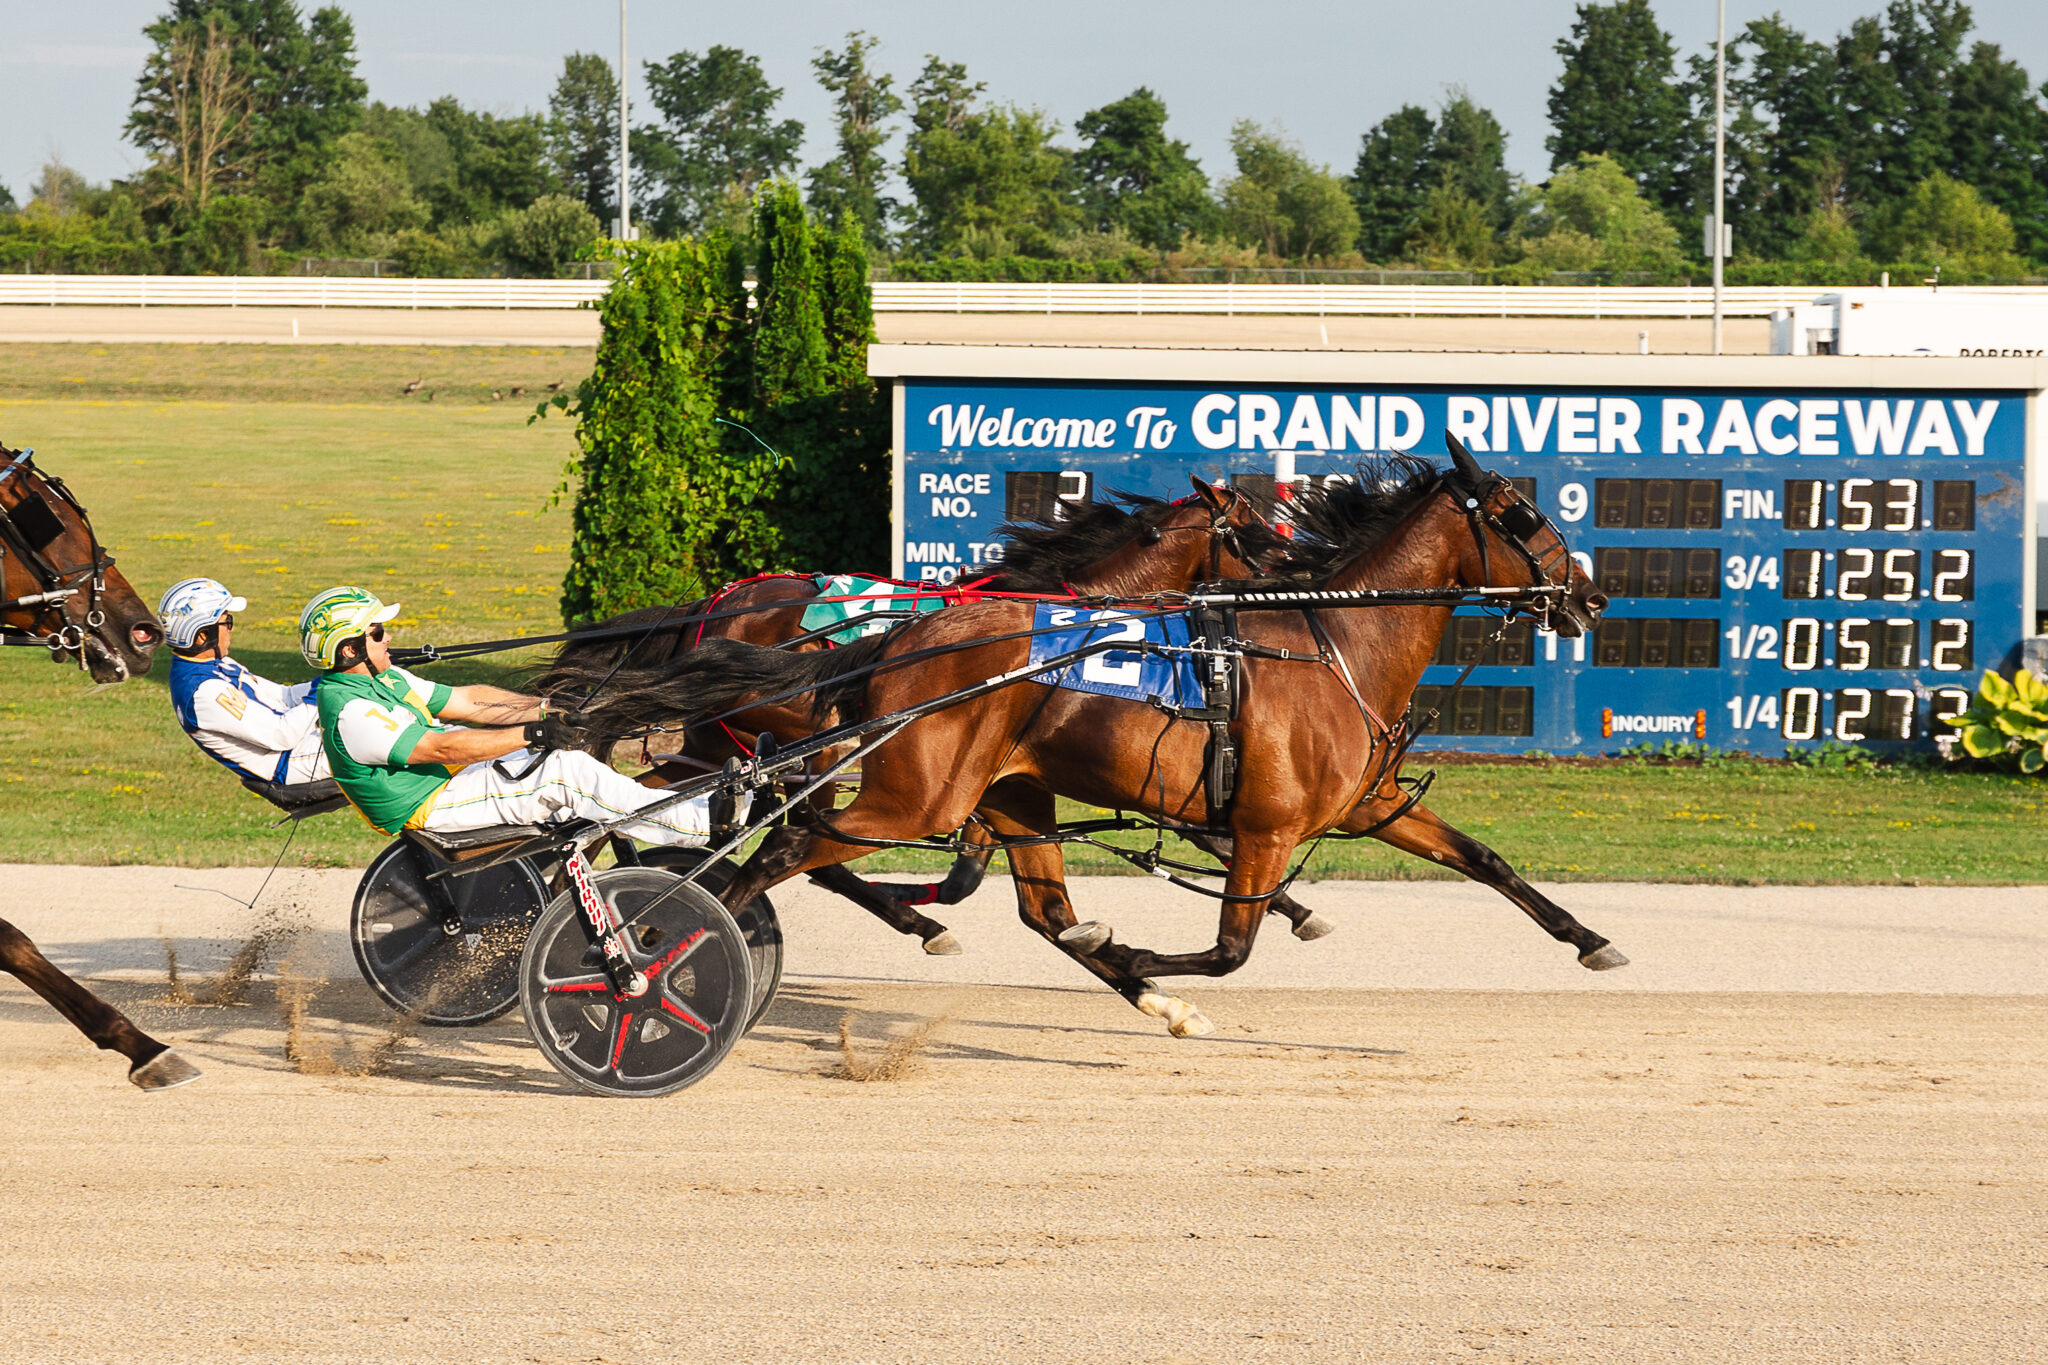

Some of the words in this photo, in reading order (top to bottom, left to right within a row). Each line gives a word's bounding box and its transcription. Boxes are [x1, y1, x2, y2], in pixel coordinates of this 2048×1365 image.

[928, 404, 1116, 449] Welcome
[1126, 406, 1177, 449] To
[1191, 393, 1424, 451] GRAND
[1447, 396, 1642, 453] RIVER
[1661, 398, 2000, 456] RACEWAY
[919, 473, 991, 494] RACE
[931, 497, 978, 518] NO.
[1558, 482, 1588, 522] 9
[1725, 490, 1782, 520] FIN.
[906, 542, 962, 563] MIN.
[968, 543, 1005, 564] TO
[1725, 555, 1780, 590] 3/4
[1809, 548, 1970, 602] 1:25.2
[1083, 610, 1146, 687] 2
[1726, 624, 1778, 660] 1/2
[1784, 617, 1968, 671] 0:57.2
[1612, 715, 1696, 733] INQUIRY
[1726, 694, 1780, 730] 1/4
